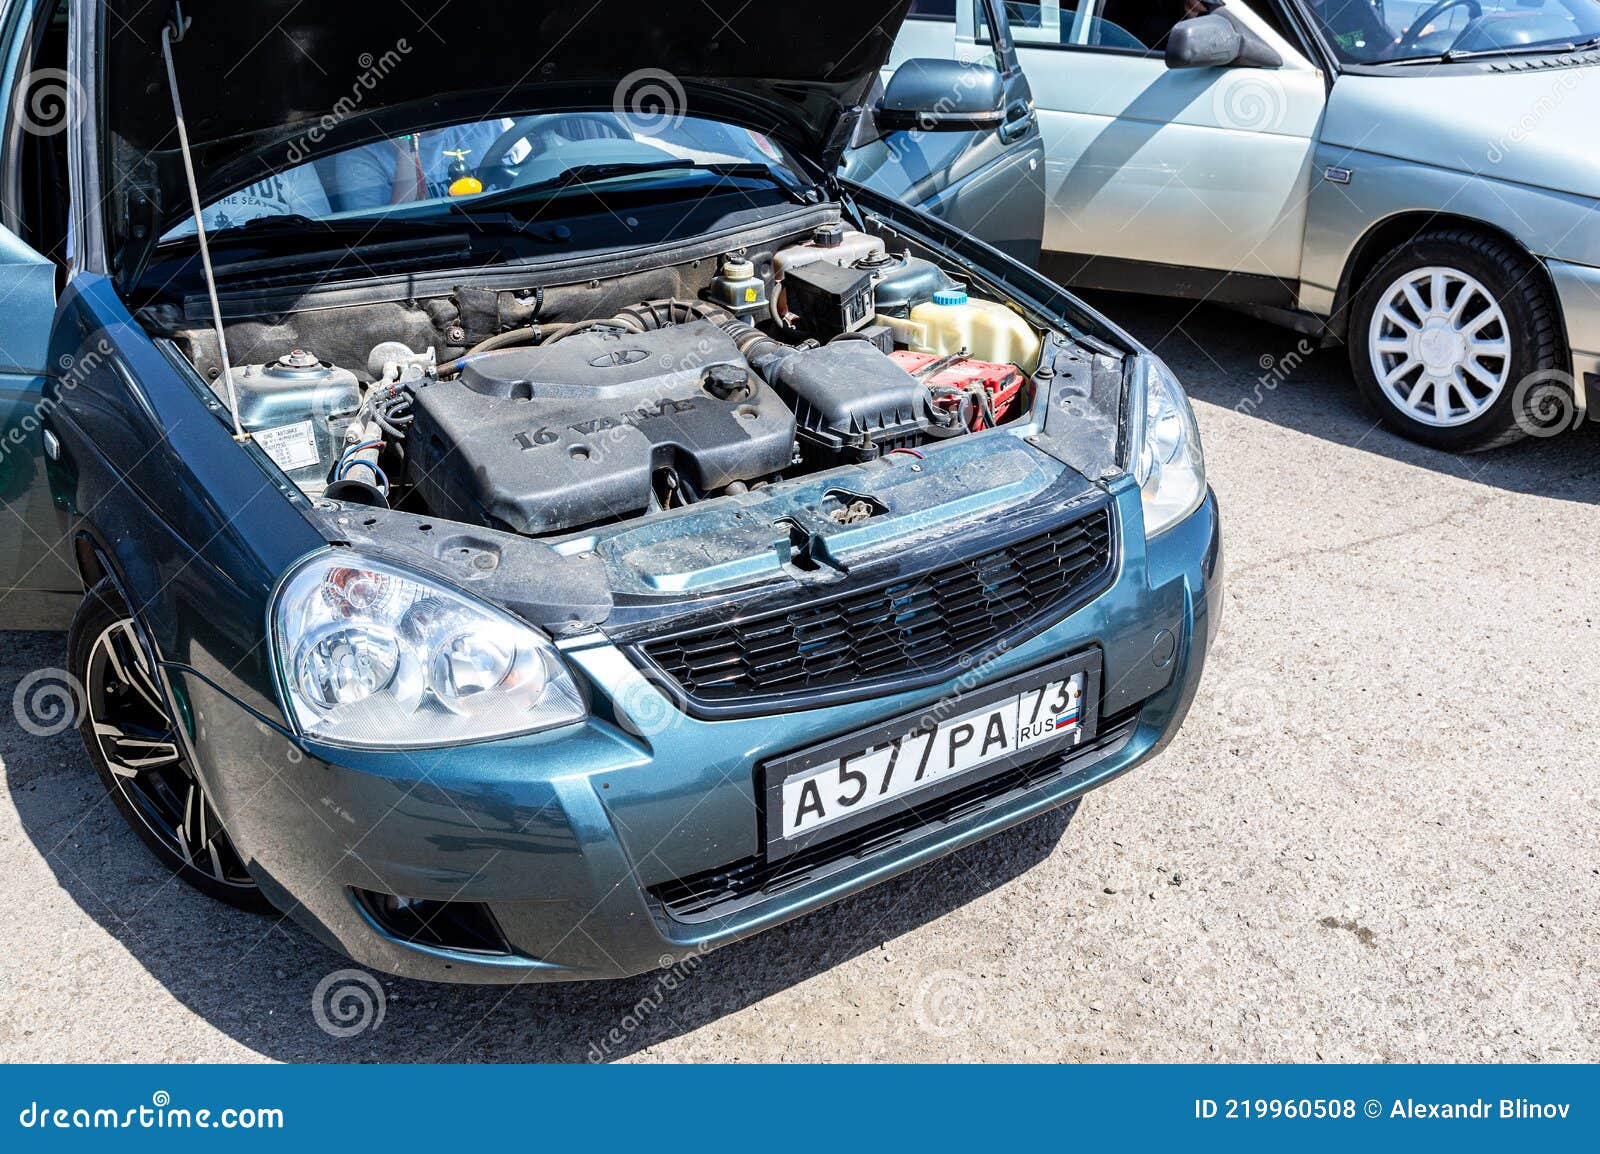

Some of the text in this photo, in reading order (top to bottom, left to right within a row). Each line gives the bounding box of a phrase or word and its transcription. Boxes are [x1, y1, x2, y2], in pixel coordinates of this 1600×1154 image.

[512, 426, 560, 451] 16
[1027, 676, 1070, 725] 73
[1020, 718, 1054, 743] RUS
